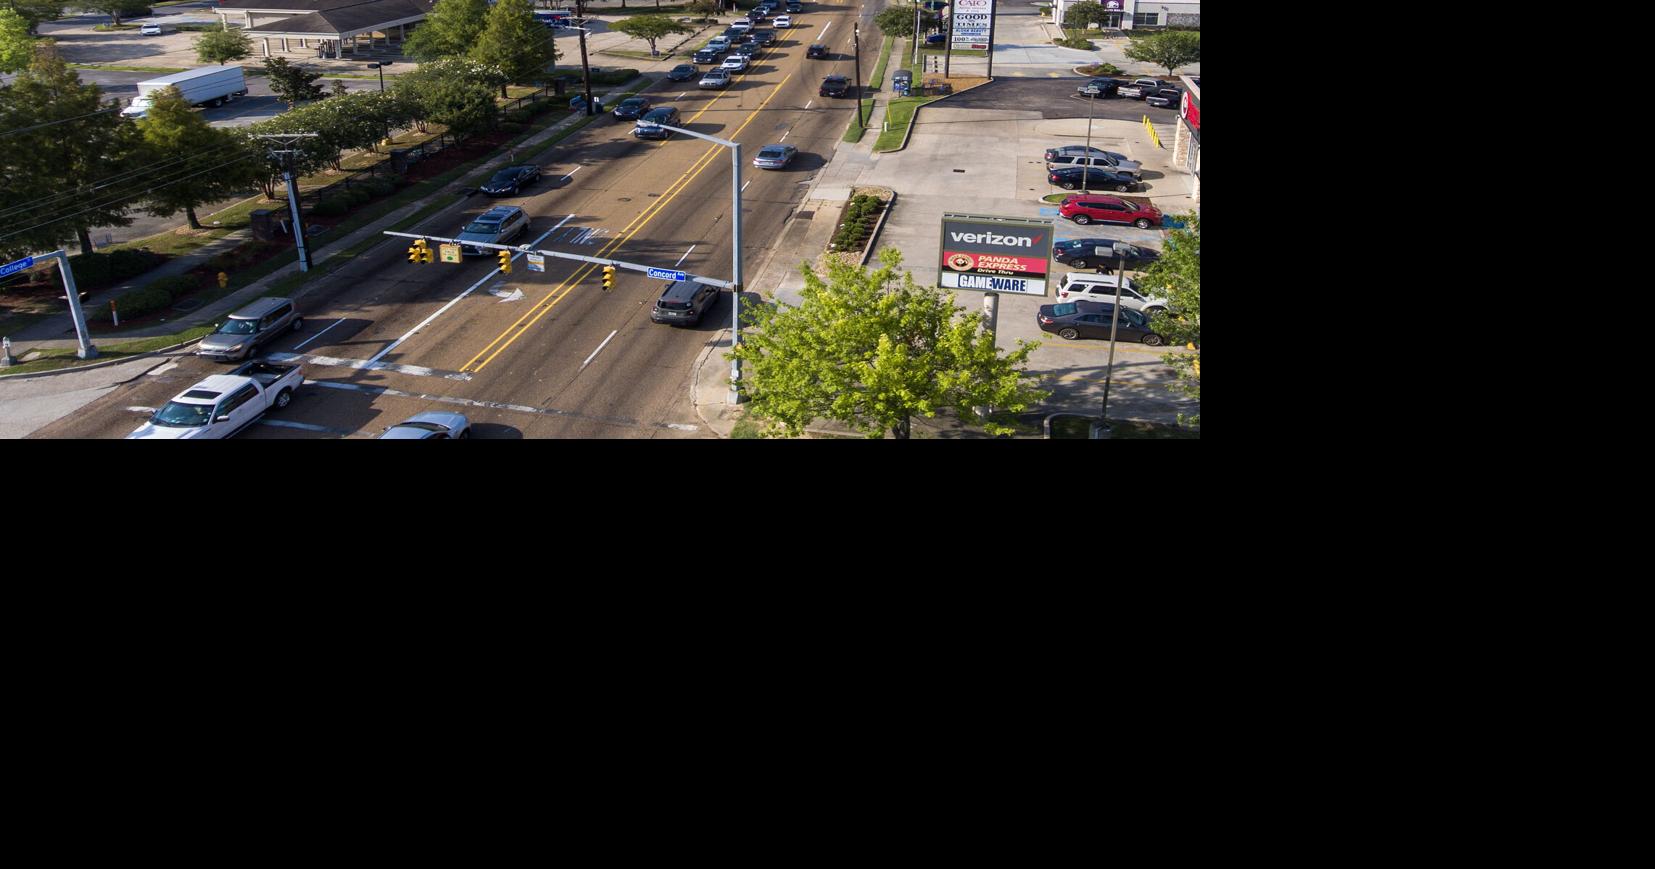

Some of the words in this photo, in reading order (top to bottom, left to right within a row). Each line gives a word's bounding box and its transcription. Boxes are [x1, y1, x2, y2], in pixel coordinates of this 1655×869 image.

[950, 231, 1032, 247] verizon
[978, 255, 1019, 263] PANDA
[0, 261, 28, 275] College
[977, 261, 1028, 271] EXPRESS
[649, 268, 677, 279] Concord
[959, 274, 1027, 292] GAMEWARE
